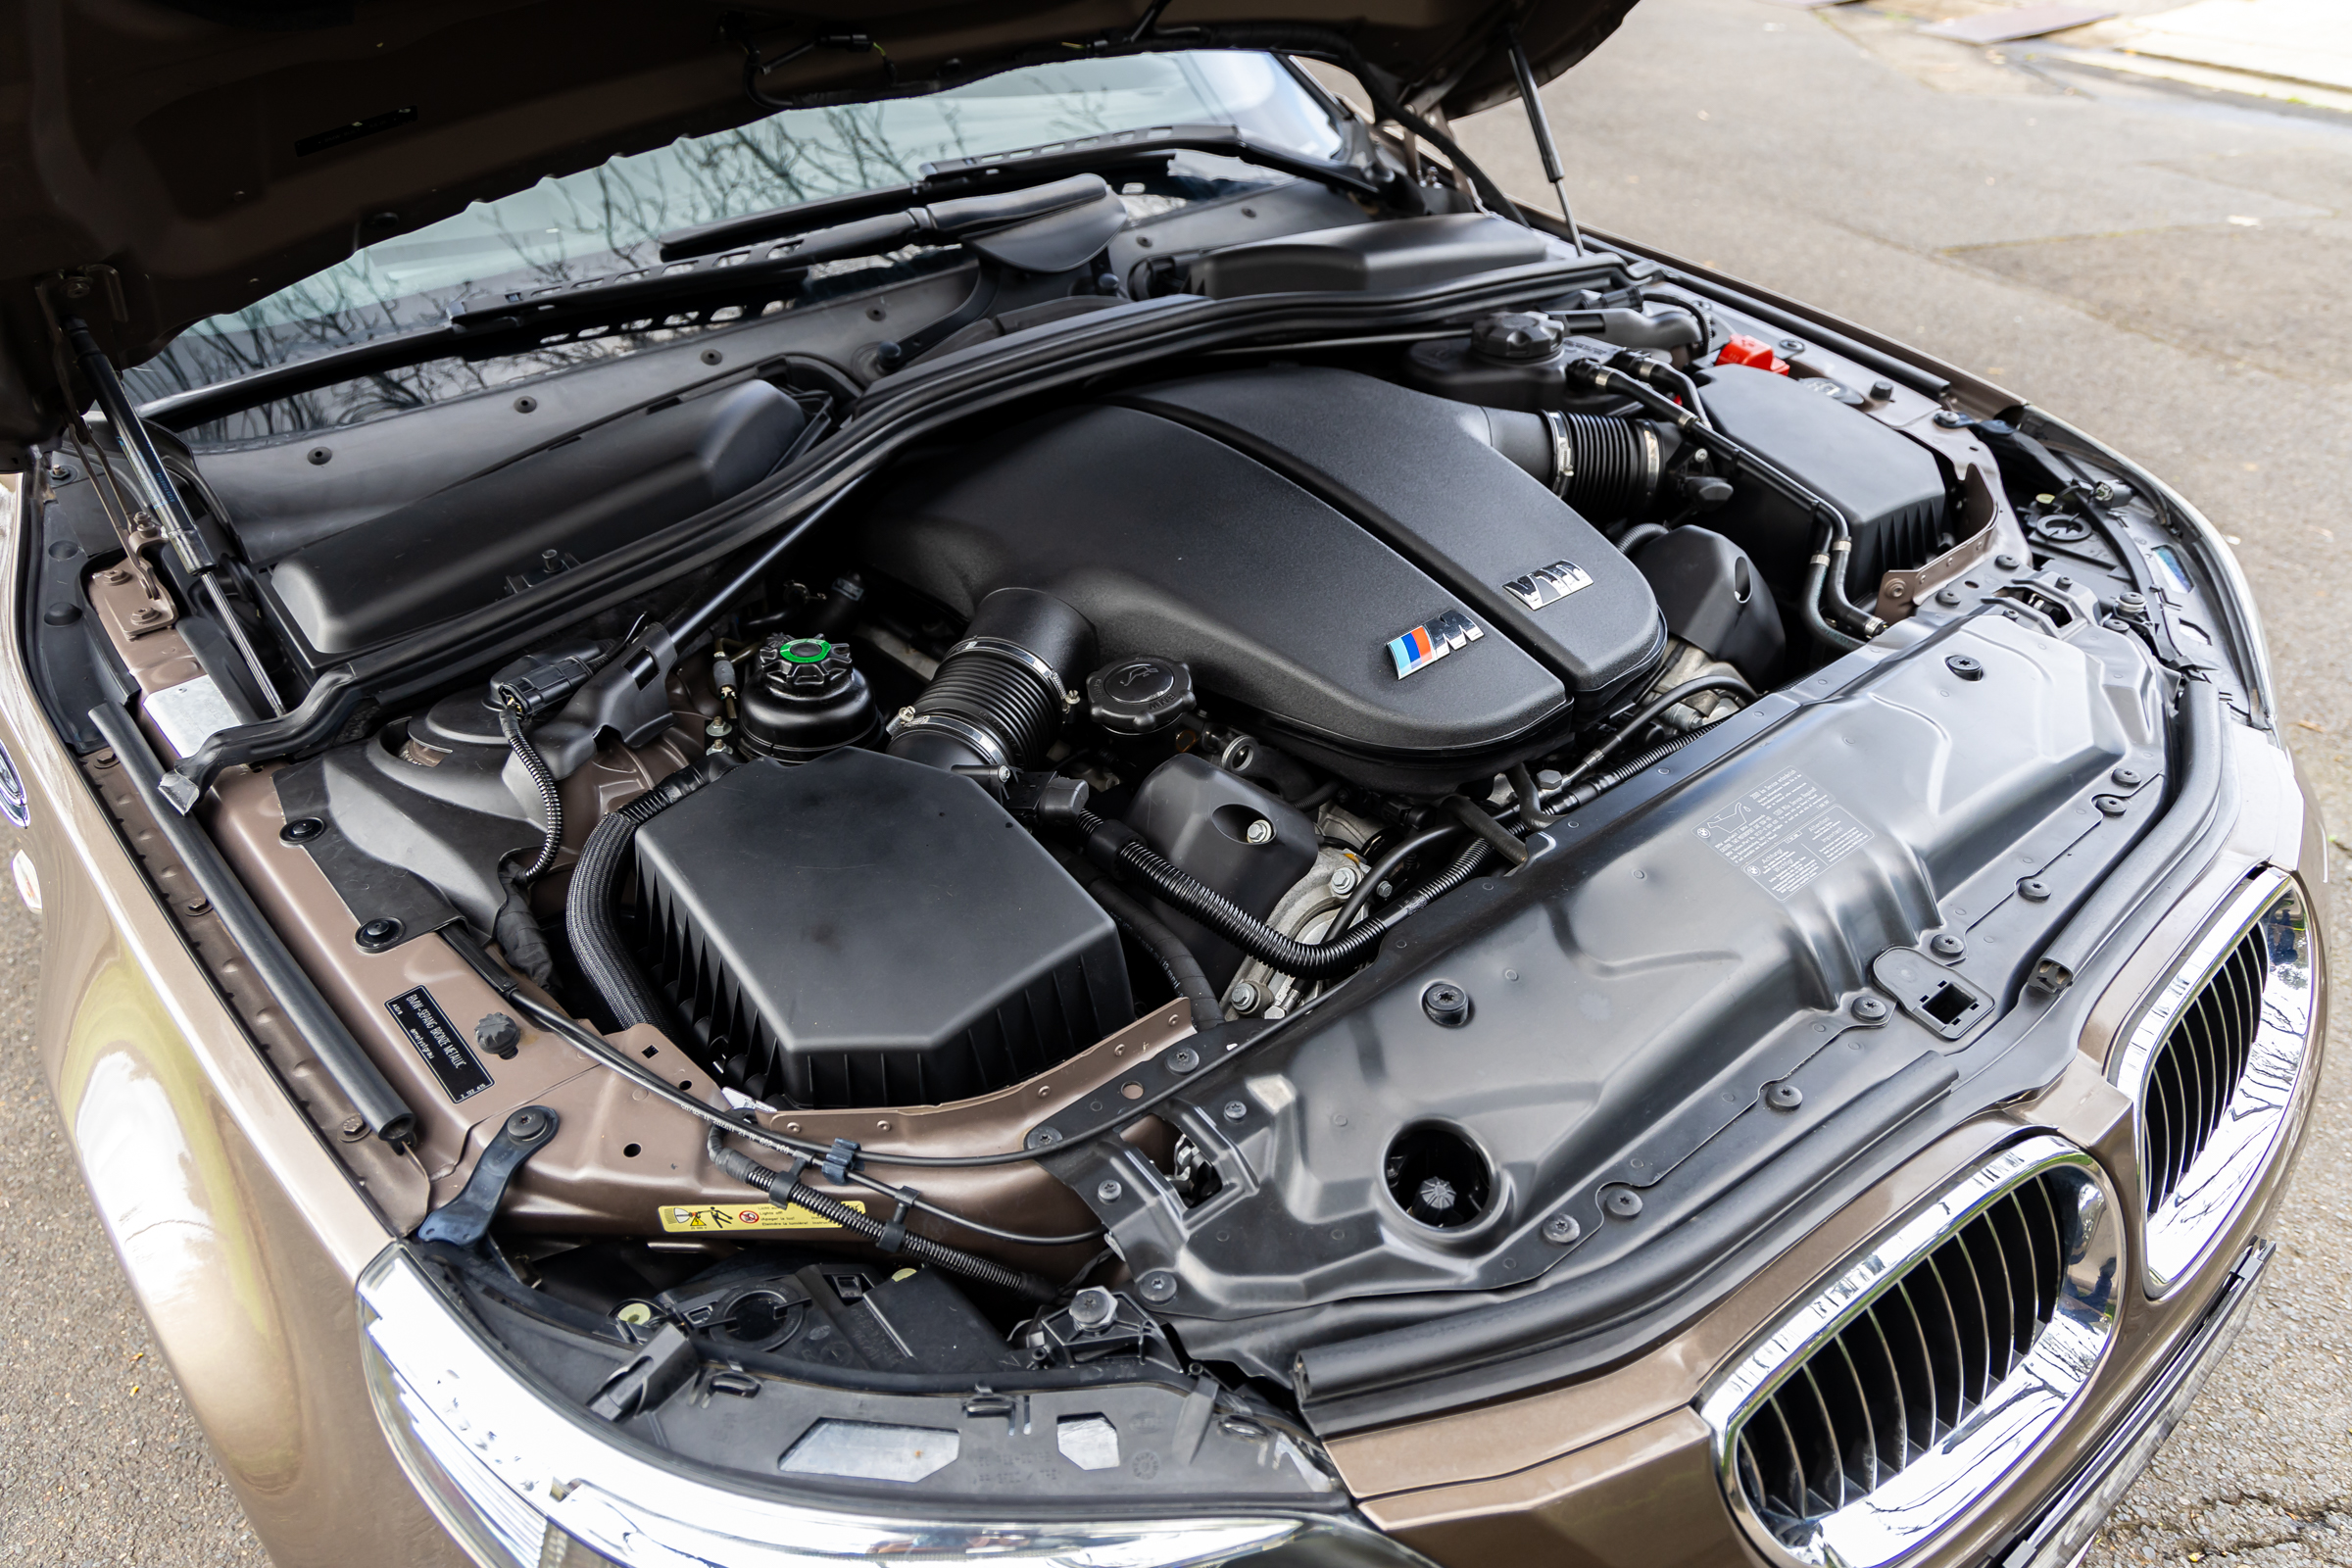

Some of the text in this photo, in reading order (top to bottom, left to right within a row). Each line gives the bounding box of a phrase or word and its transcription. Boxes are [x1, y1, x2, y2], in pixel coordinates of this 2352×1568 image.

[1149, 693, 1177, 710] BMW
[406, 994, 466, 1068] BMW-SEPANG BRONZE METALLIC
